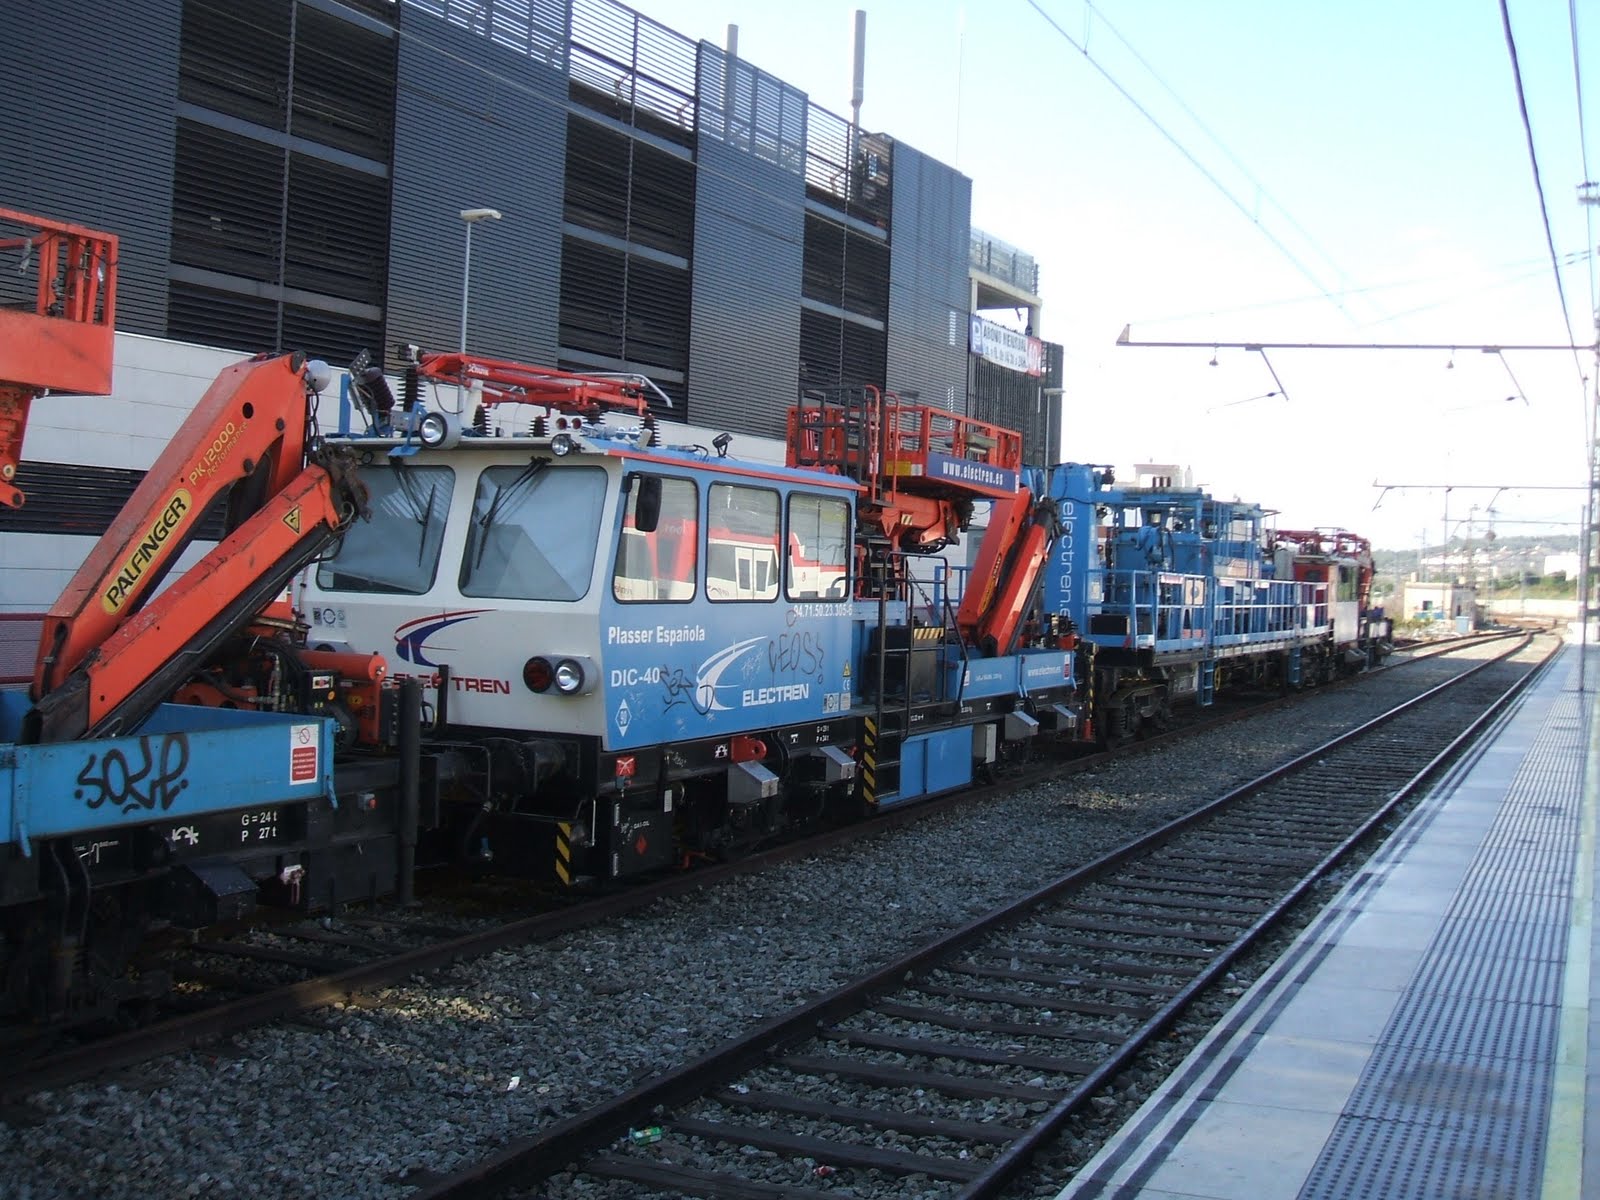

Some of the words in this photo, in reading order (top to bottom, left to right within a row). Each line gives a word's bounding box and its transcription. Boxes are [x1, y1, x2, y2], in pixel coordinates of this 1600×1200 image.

[189, 462, 206, 486] PK
[203, 422, 235, 466] 12000
[206, 421, 248, 478] Performance
[942, 461, 1004, 486] www.electren.es
[106, 496, 187, 607] PALFINGER
[608, 626, 654, 645] Plasser
[656, 624, 706, 646] Española
[611, 667, 661, 687] DIC-40
[742, 683, 809, 707] ELECTREN
[241, 814, 250, 826] G
[260, 811, 271, 824] 24
[241, 830, 249, 842] P
[259, 827, 270, 839] 27
